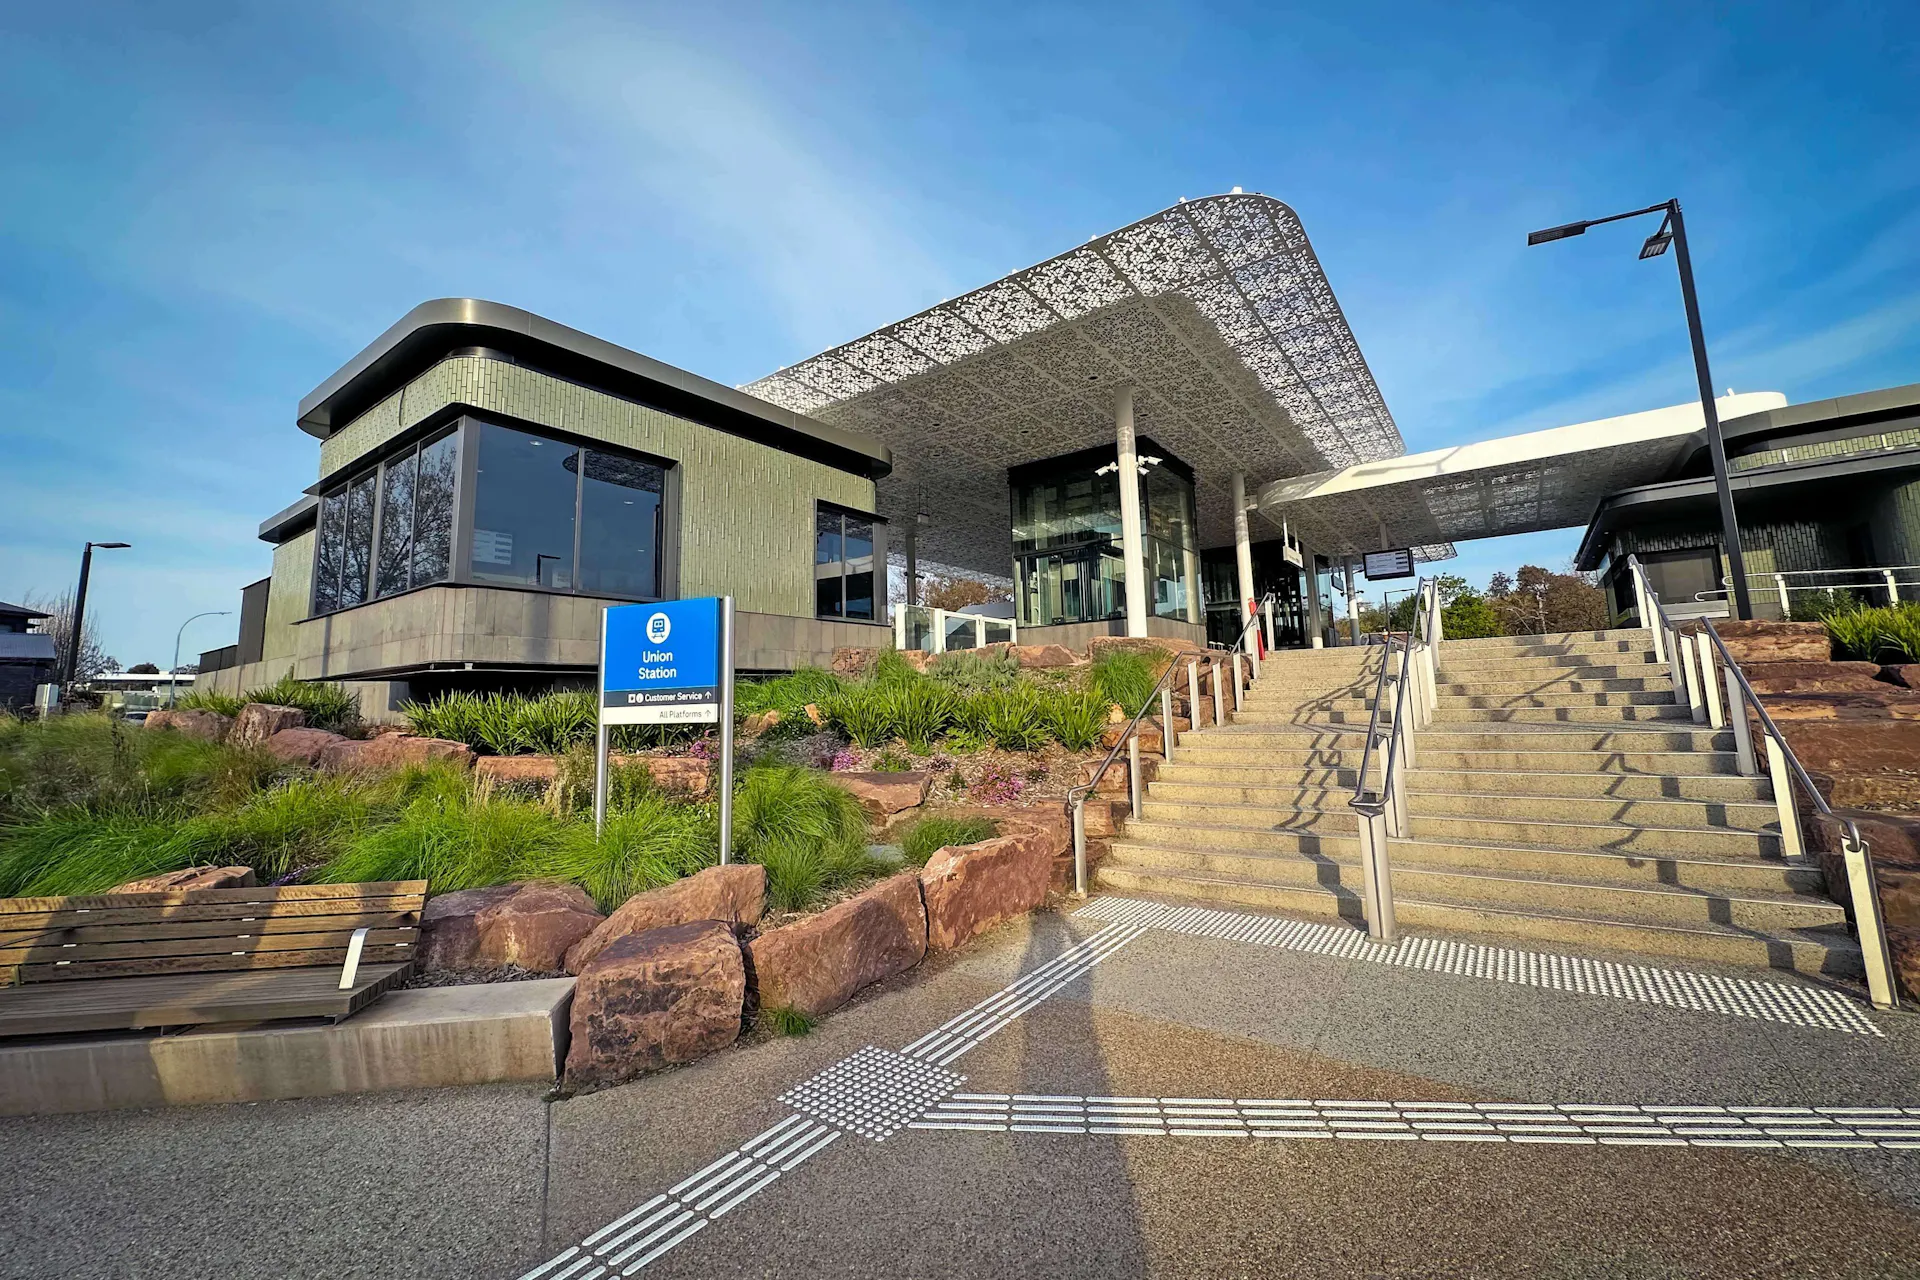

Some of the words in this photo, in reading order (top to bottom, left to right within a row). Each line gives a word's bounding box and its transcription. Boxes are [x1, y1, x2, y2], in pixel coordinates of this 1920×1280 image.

[642, 650, 673, 663] Union
[638, 666, 677, 680] Station
[645, 693, 676, 702] Customer
[677, 691, 702, 701] Service
[659, 711, 668, 719] All
[669, 710, 702, 719] Platforms
